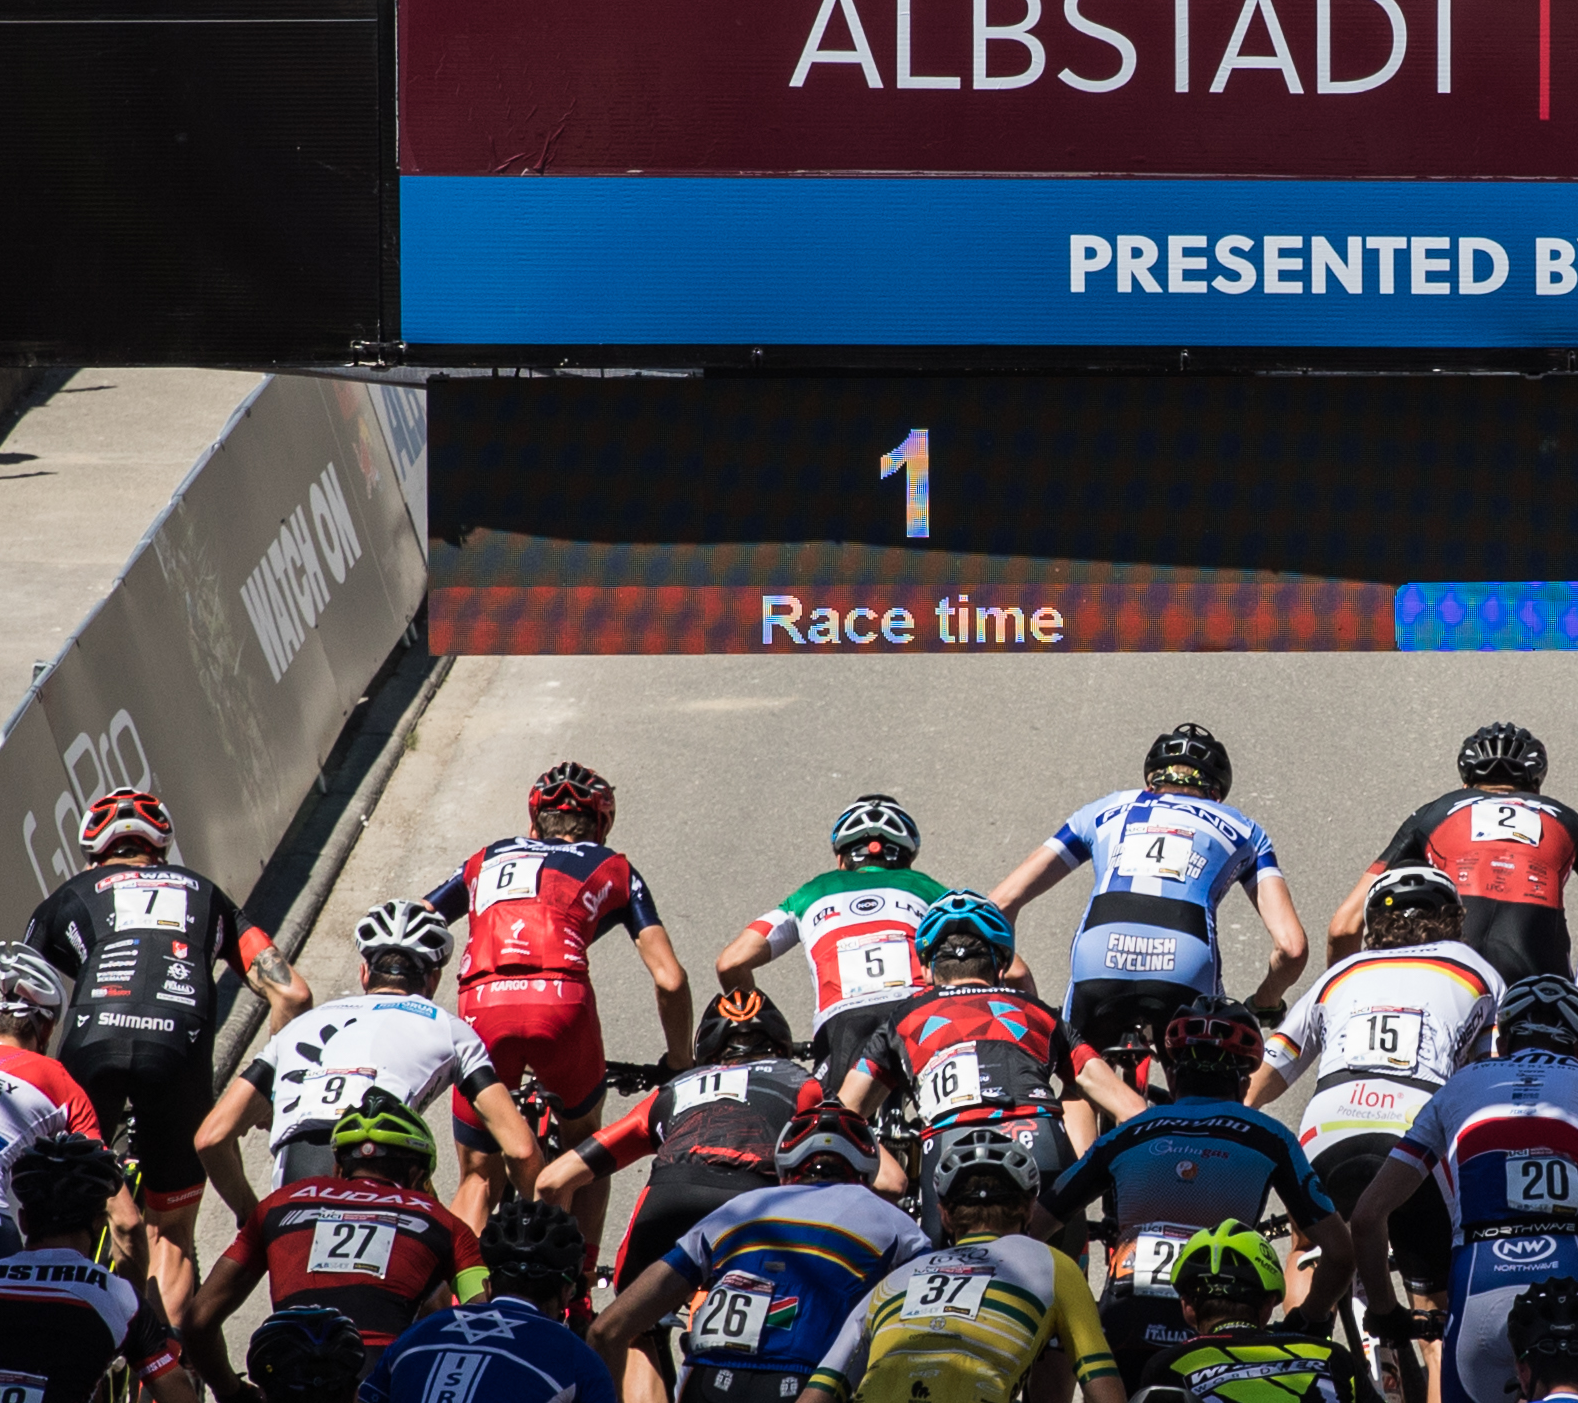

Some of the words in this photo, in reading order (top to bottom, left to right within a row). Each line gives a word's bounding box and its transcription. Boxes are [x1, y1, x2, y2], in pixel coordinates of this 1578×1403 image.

[1068, 232, 1508, 297] PRESENTED
[881, 429, 929, 538] 1
[239, 503, 325, 685] WATCH
[319, 463, 362, 588] ON
[762, 595, 915, 646] Race
[936, 593, 1063, 644] time
[1102, 797, 1238, 841] FINLAND
[1498, 806, 1515, 829] 2
[1145, 837, 1166, 864] 4
[497, 862, 517, 890] 6
[142, 890, 159, 914] 7
[1107, 933, 1176, 954] FINNISH
[865, 948, 884, 977] 5
[1106, 950, 1175, 972] CYCLING
[98, 1012, 175, 1032] SHIMANO
[1367, 1015, 1398, 1050] 15
[1349, 1082, 1395, 1109] ilon
[1337, 1105, 1403, 1121] Protect-Salbe
[1521, 1161, 1566, 1201] 20
[289, 1185, 434, 1211] AUDAX
[332, 1224, 379, 1259] 27
[1472, 1222, 1576, 1239] NORTHWAVE
[926, 1274, 972, 1305] 37
